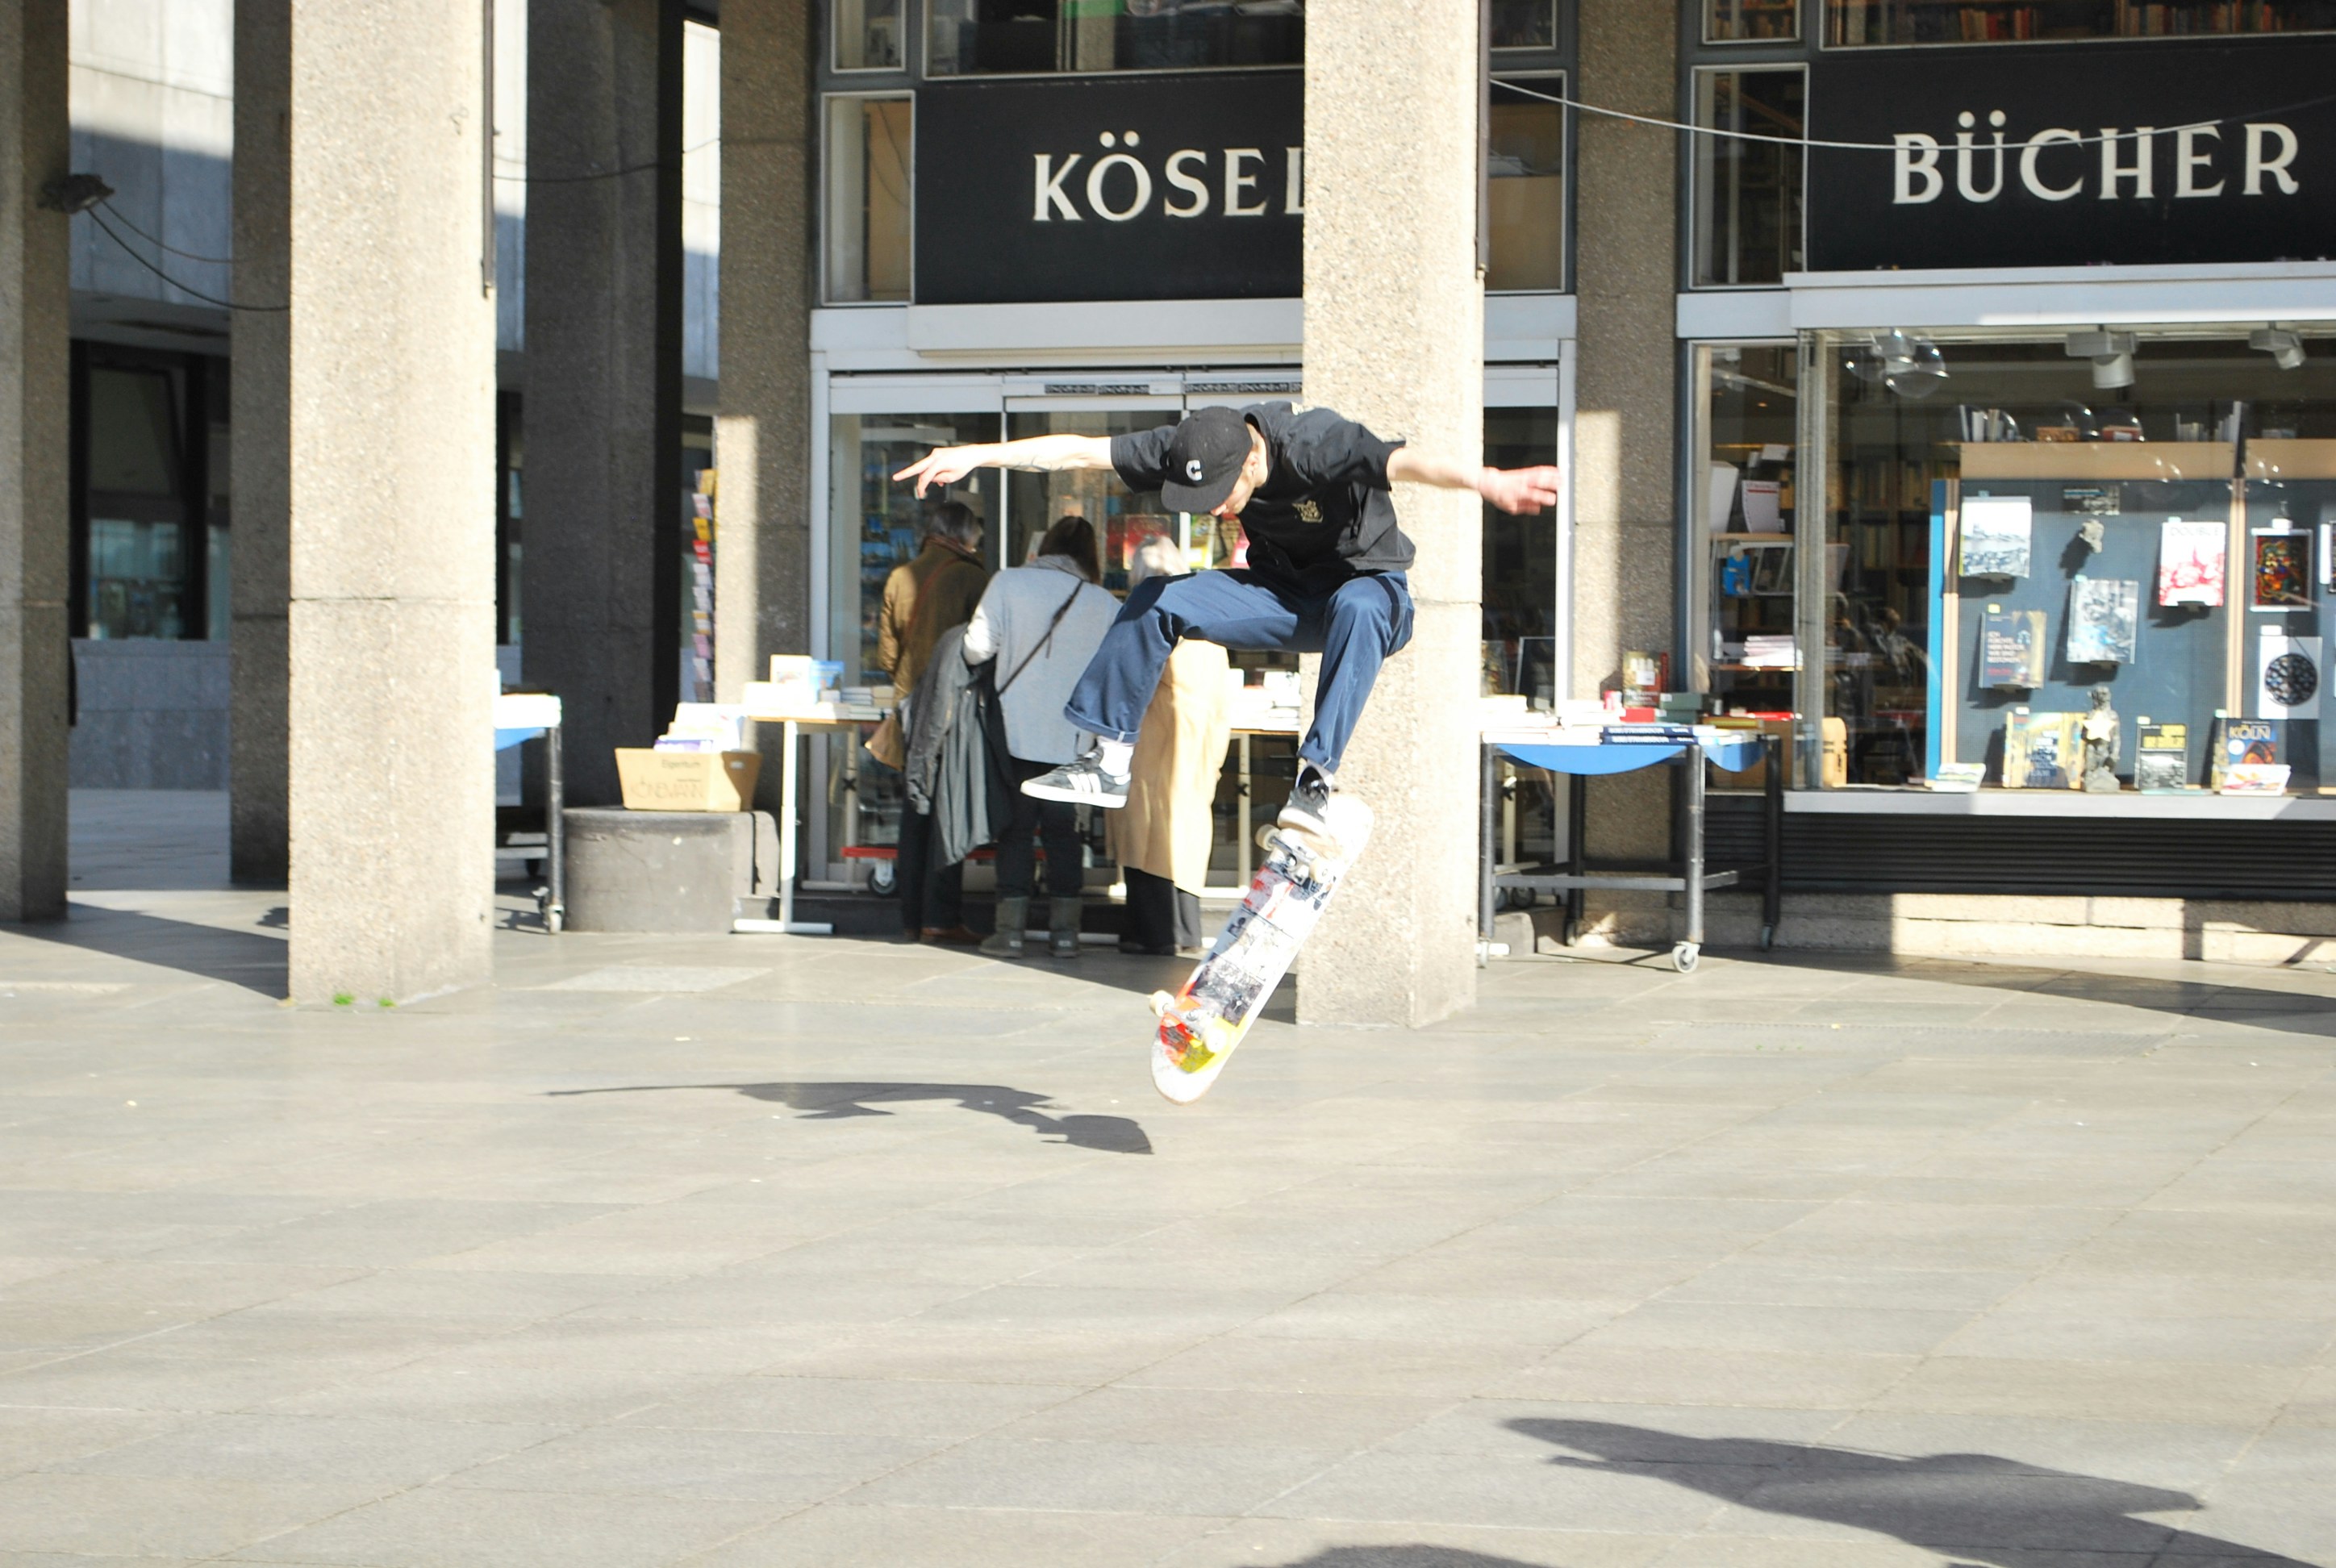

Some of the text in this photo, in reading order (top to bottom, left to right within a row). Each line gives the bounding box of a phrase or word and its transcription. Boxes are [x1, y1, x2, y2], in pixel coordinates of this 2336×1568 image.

[1033, 131, 1304, 222] KÖSEL
[1892, 110, 2300, 205] BÜCHER
[1186, 459, 1203, 482] C
[2229, 724, 2271, 740] KÖLN
